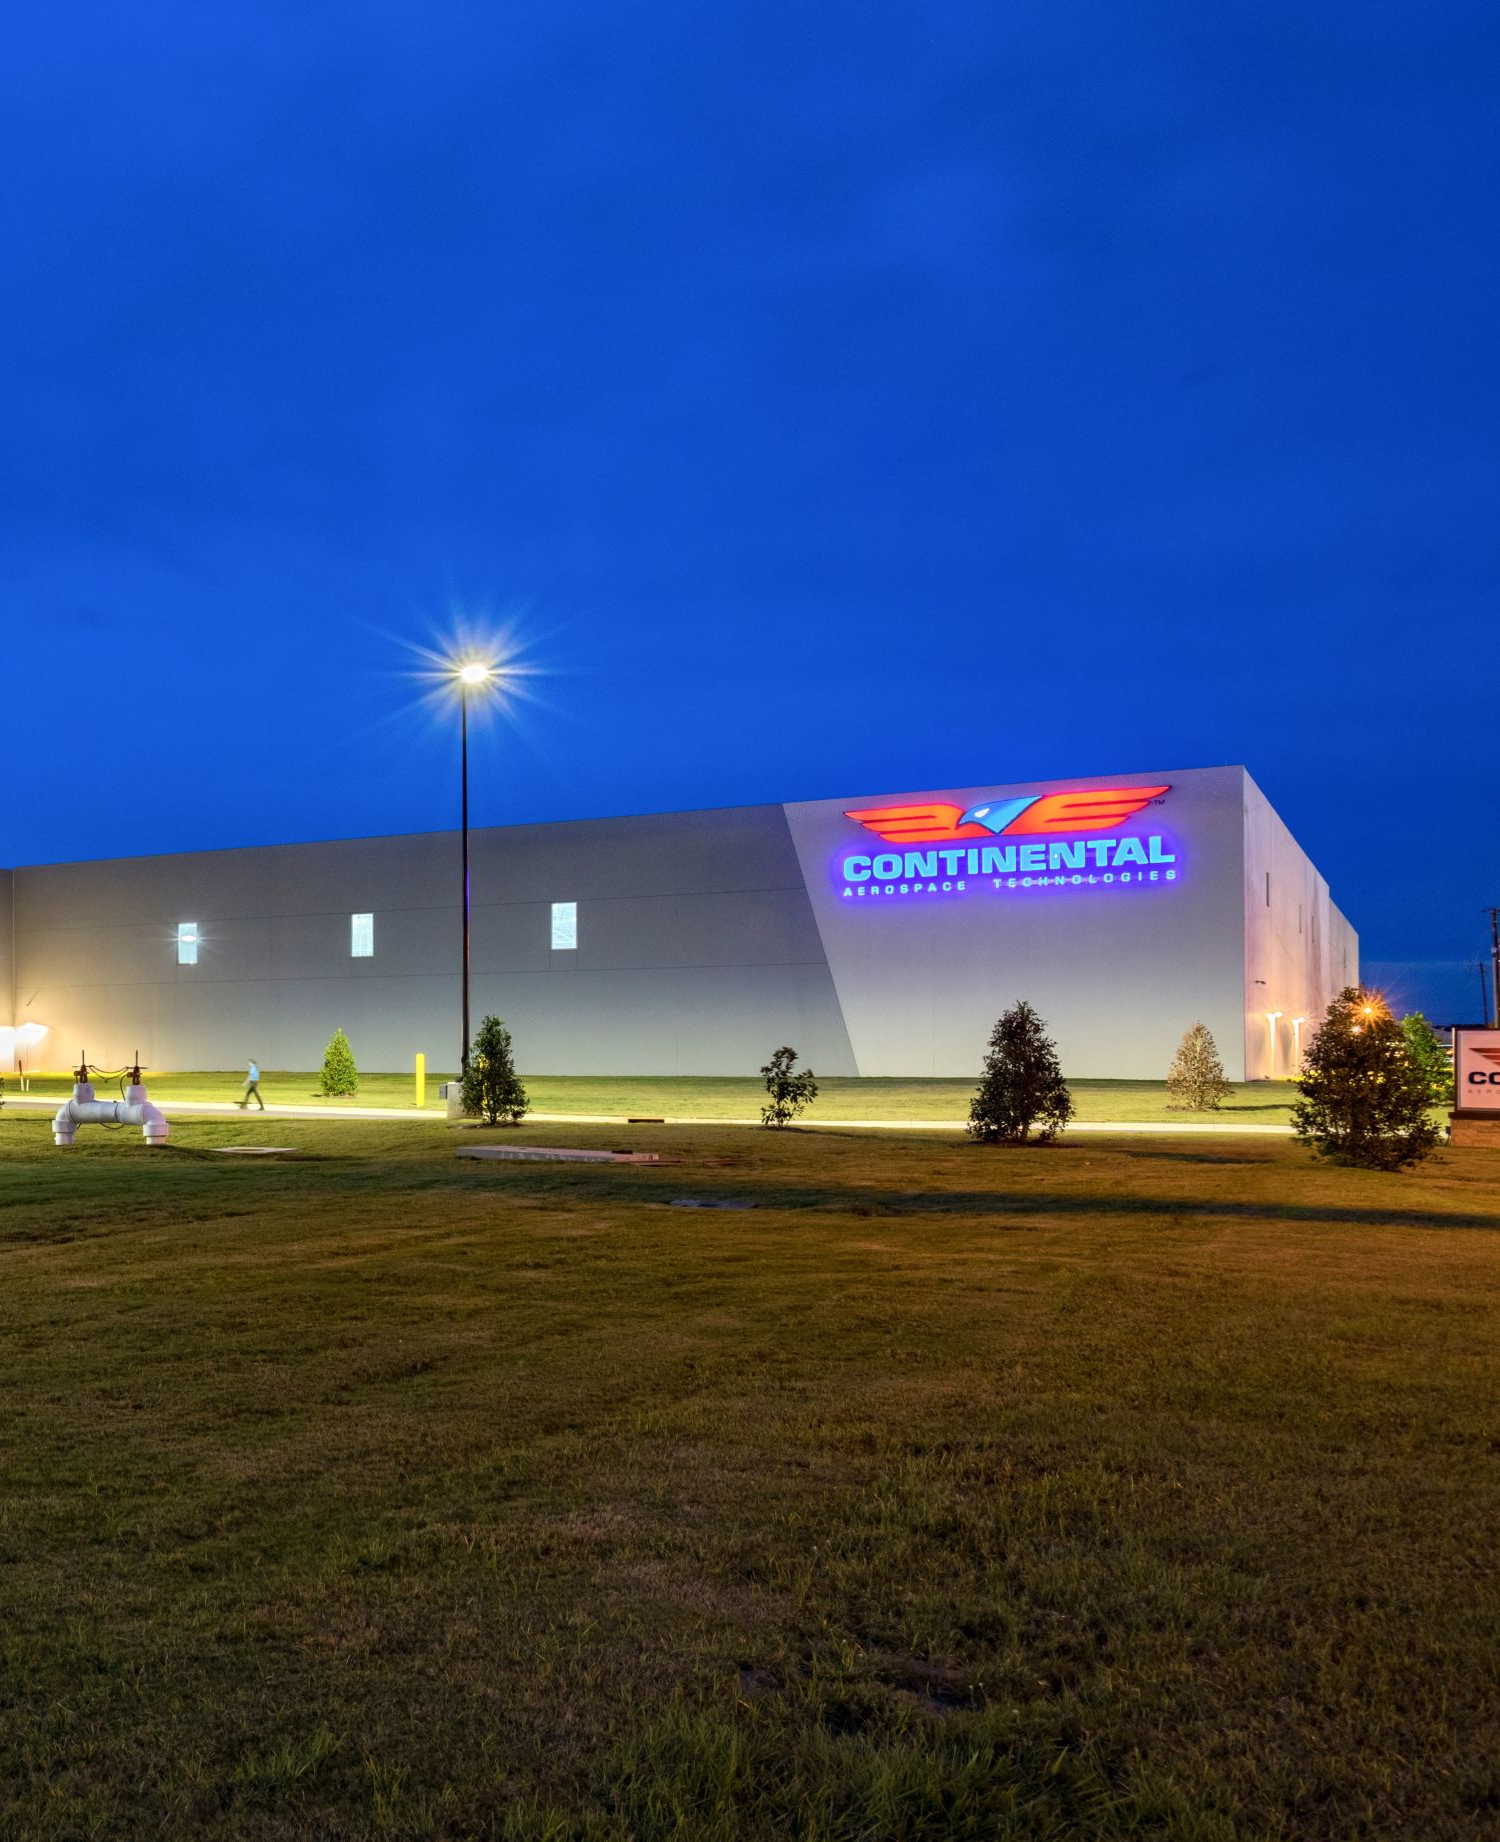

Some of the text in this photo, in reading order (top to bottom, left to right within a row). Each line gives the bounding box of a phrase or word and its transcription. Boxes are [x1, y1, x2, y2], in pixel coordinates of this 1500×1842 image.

[843, 836, 1176, 882] CONTINENTAL
[843, 870, 1177, 897] AEROSPACE TECHNOLOGIES
